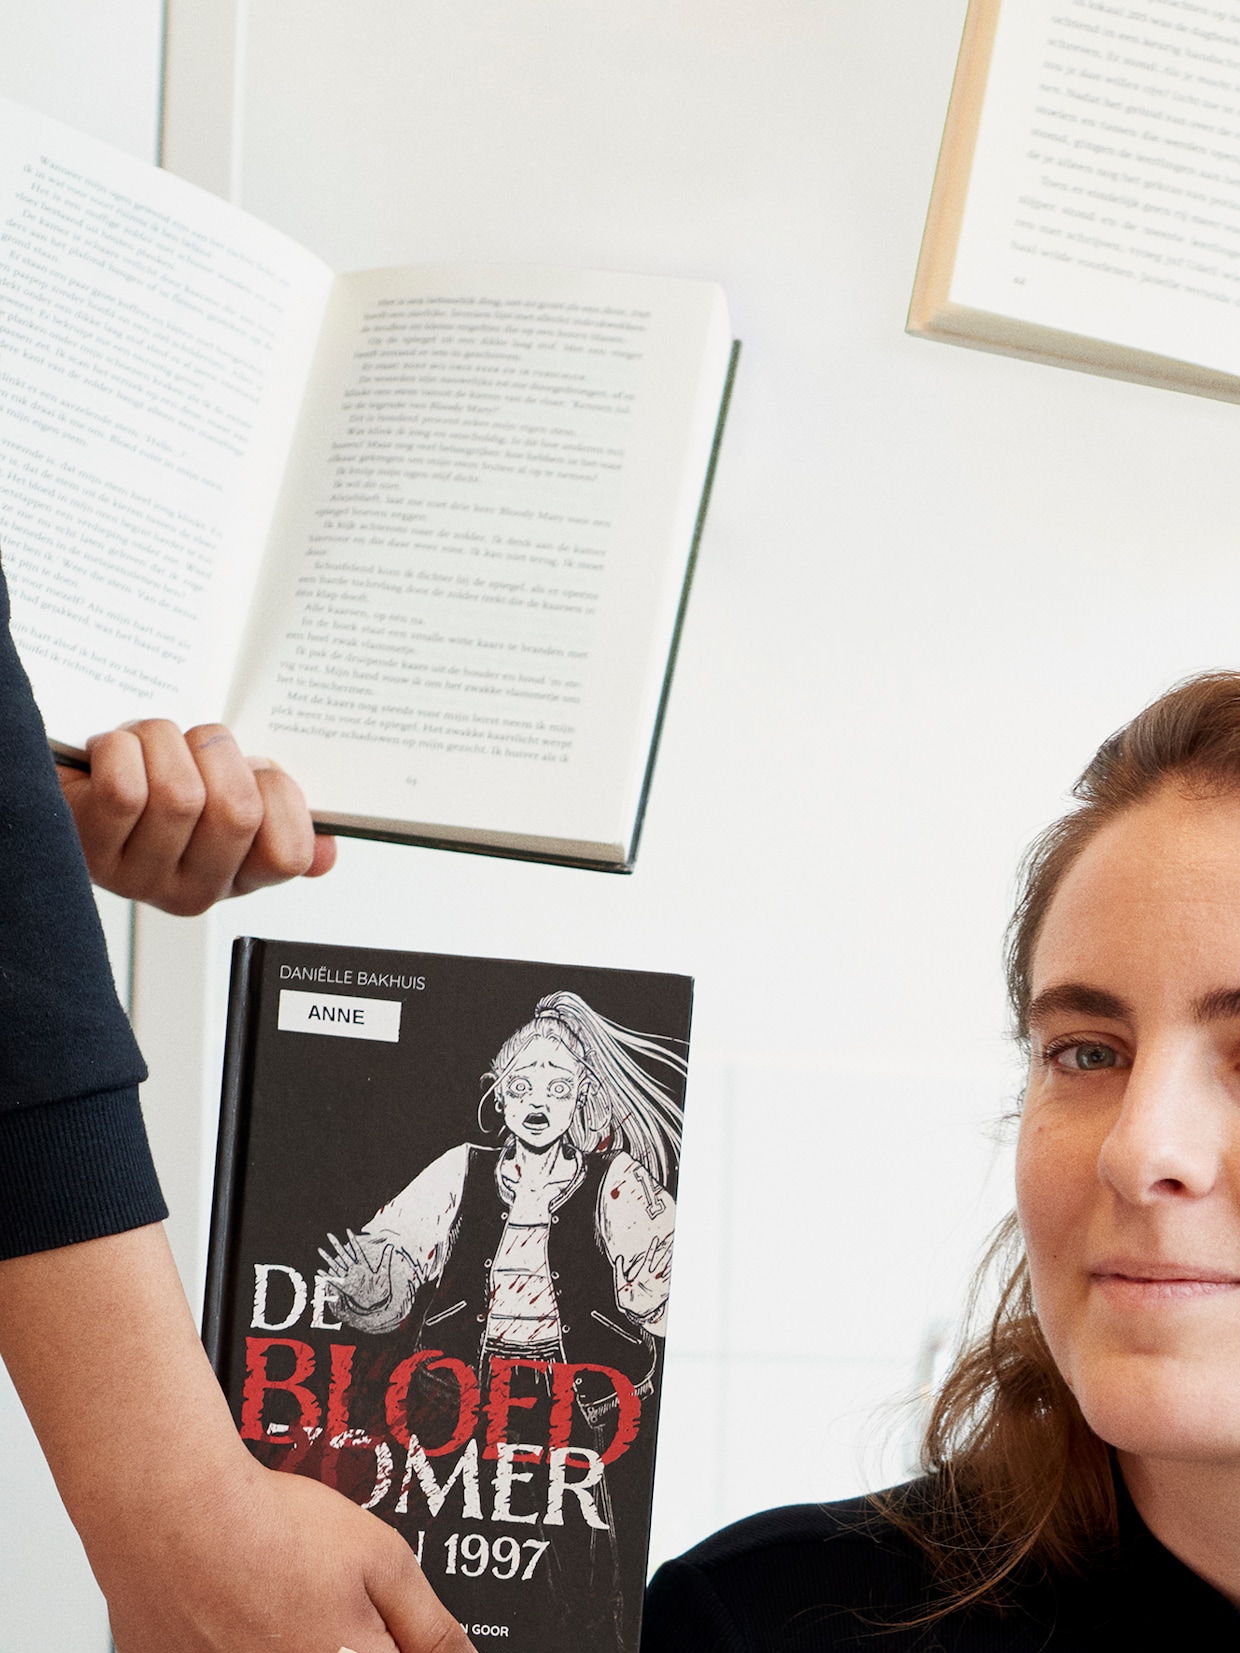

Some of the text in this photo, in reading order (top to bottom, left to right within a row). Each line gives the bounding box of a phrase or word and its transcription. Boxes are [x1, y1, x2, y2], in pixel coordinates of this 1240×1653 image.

[279, 965, 426, 991] DANIËLLE BAKHUIS
[308, 1005, 365, 1025] ANNE
[250, 1263, 345, 1330] DE
[238, 1336, 641, 1469] BLOED
[443, 1533, 551, 1581] 1997
[471, 1624, 509, 1637] GOOR
